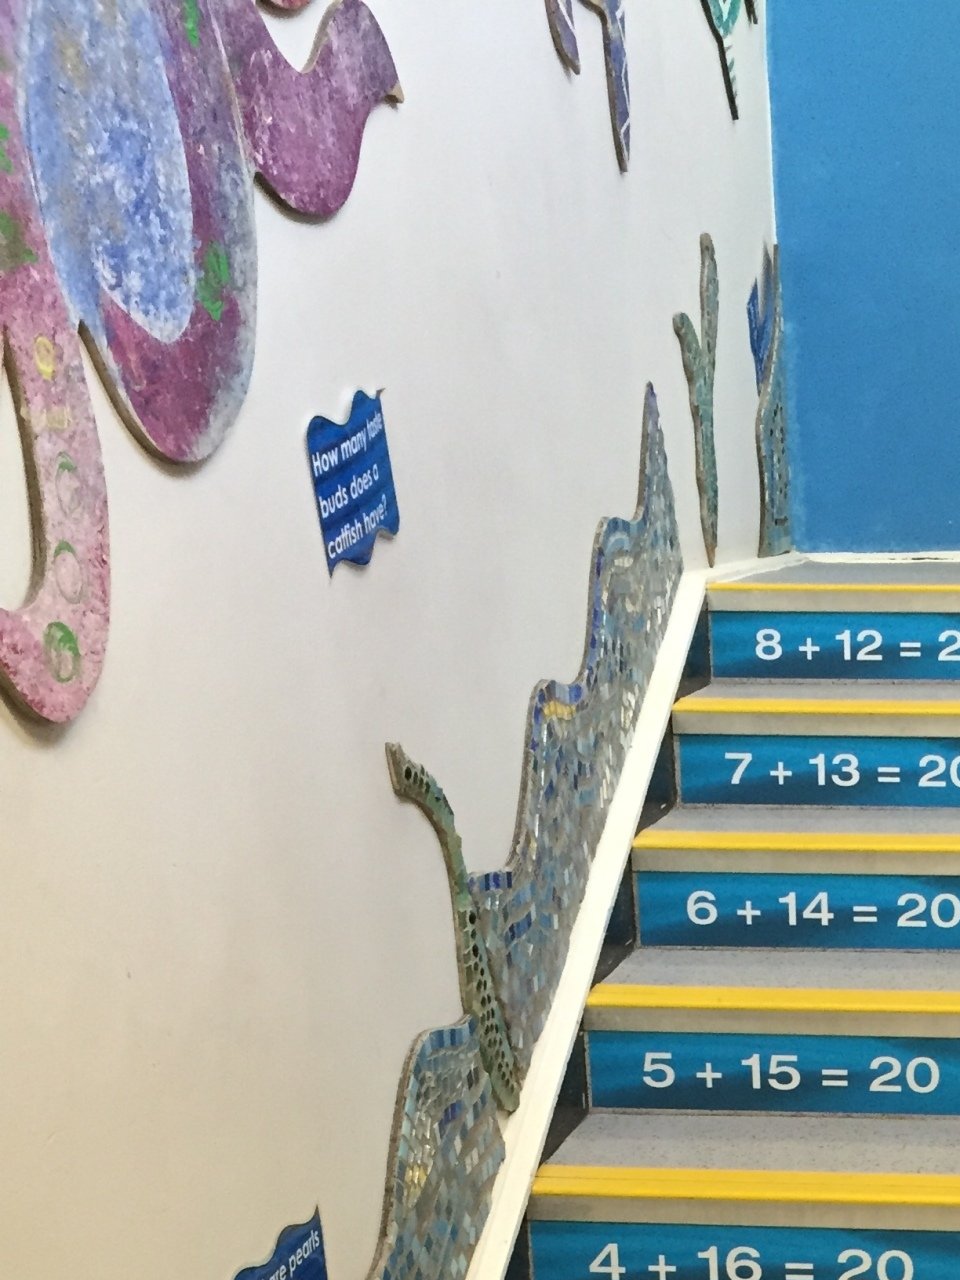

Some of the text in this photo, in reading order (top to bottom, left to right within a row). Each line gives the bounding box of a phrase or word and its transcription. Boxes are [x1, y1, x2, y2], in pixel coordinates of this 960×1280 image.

[312, 447, 339, 477] How
[341, 429, 367, 461] many
[319, 463, 379, 519] buds does a
[328, 493, 388, 559] catfish have?
[755, 628, 783, 661] 8
[798, 637, 820, 661] +
[835, 629, 883, 661] 12
[899, 641, 922, 657] =
[724, 752, 753, 785] 7
[769, 761, 793, 785] +
[809, 753, 860, 787] 13
[877, 766, 901, 783] =
[686, 890, 718, 925] 6
[736, 900, 761, 925] +
[778, 891, 835, 926] 14
[852, 905, 878, 923] =
[643, 1052, 940, 1094] 5 + 15 = 20
[289, 1230, 320, 1277] pearls
[589, 1243, 626, 1280] 4
[784, 1262, 814, 1280] =
